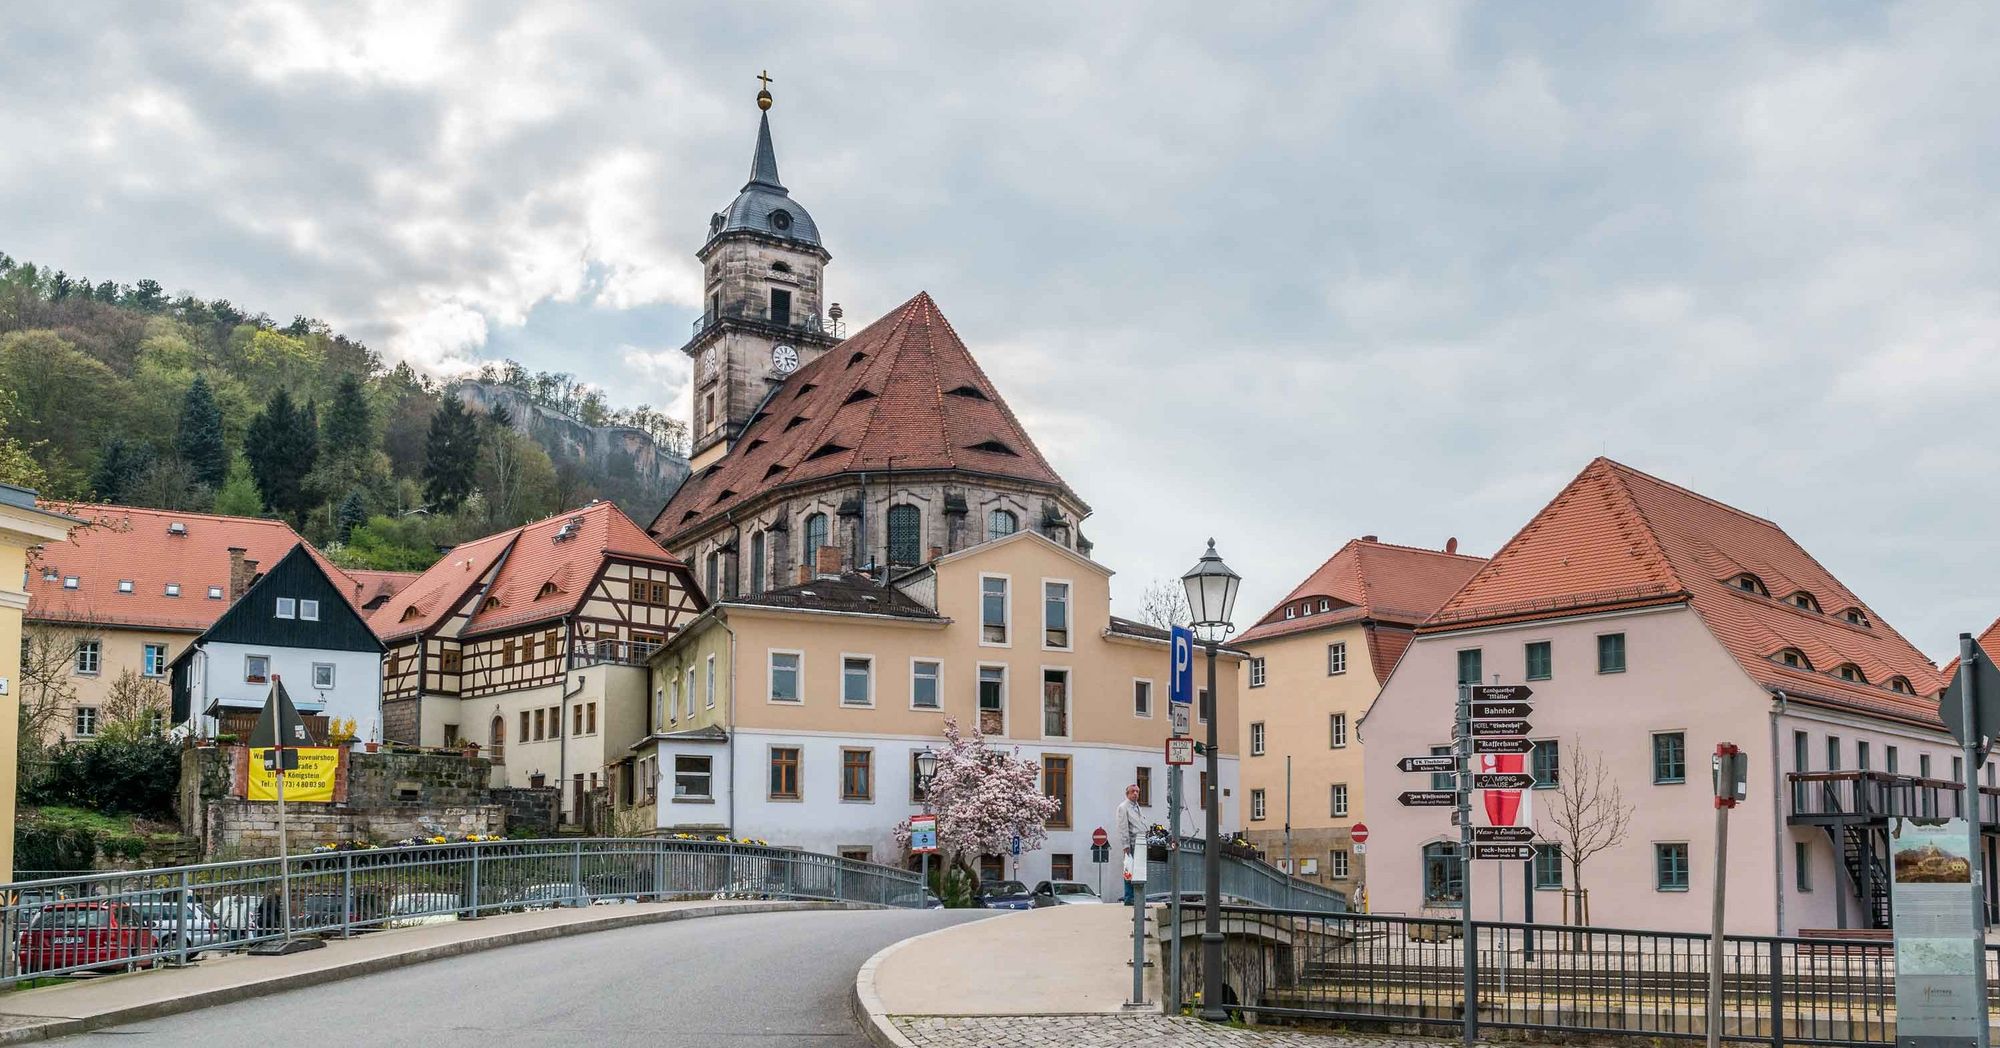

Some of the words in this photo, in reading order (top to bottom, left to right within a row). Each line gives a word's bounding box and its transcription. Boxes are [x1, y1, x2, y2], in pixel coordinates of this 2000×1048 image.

[1176, 636, 1188, 693] P
[297, 754, 334, 762] ouvenirshop
[287, 771, 320, 779] Königstein
